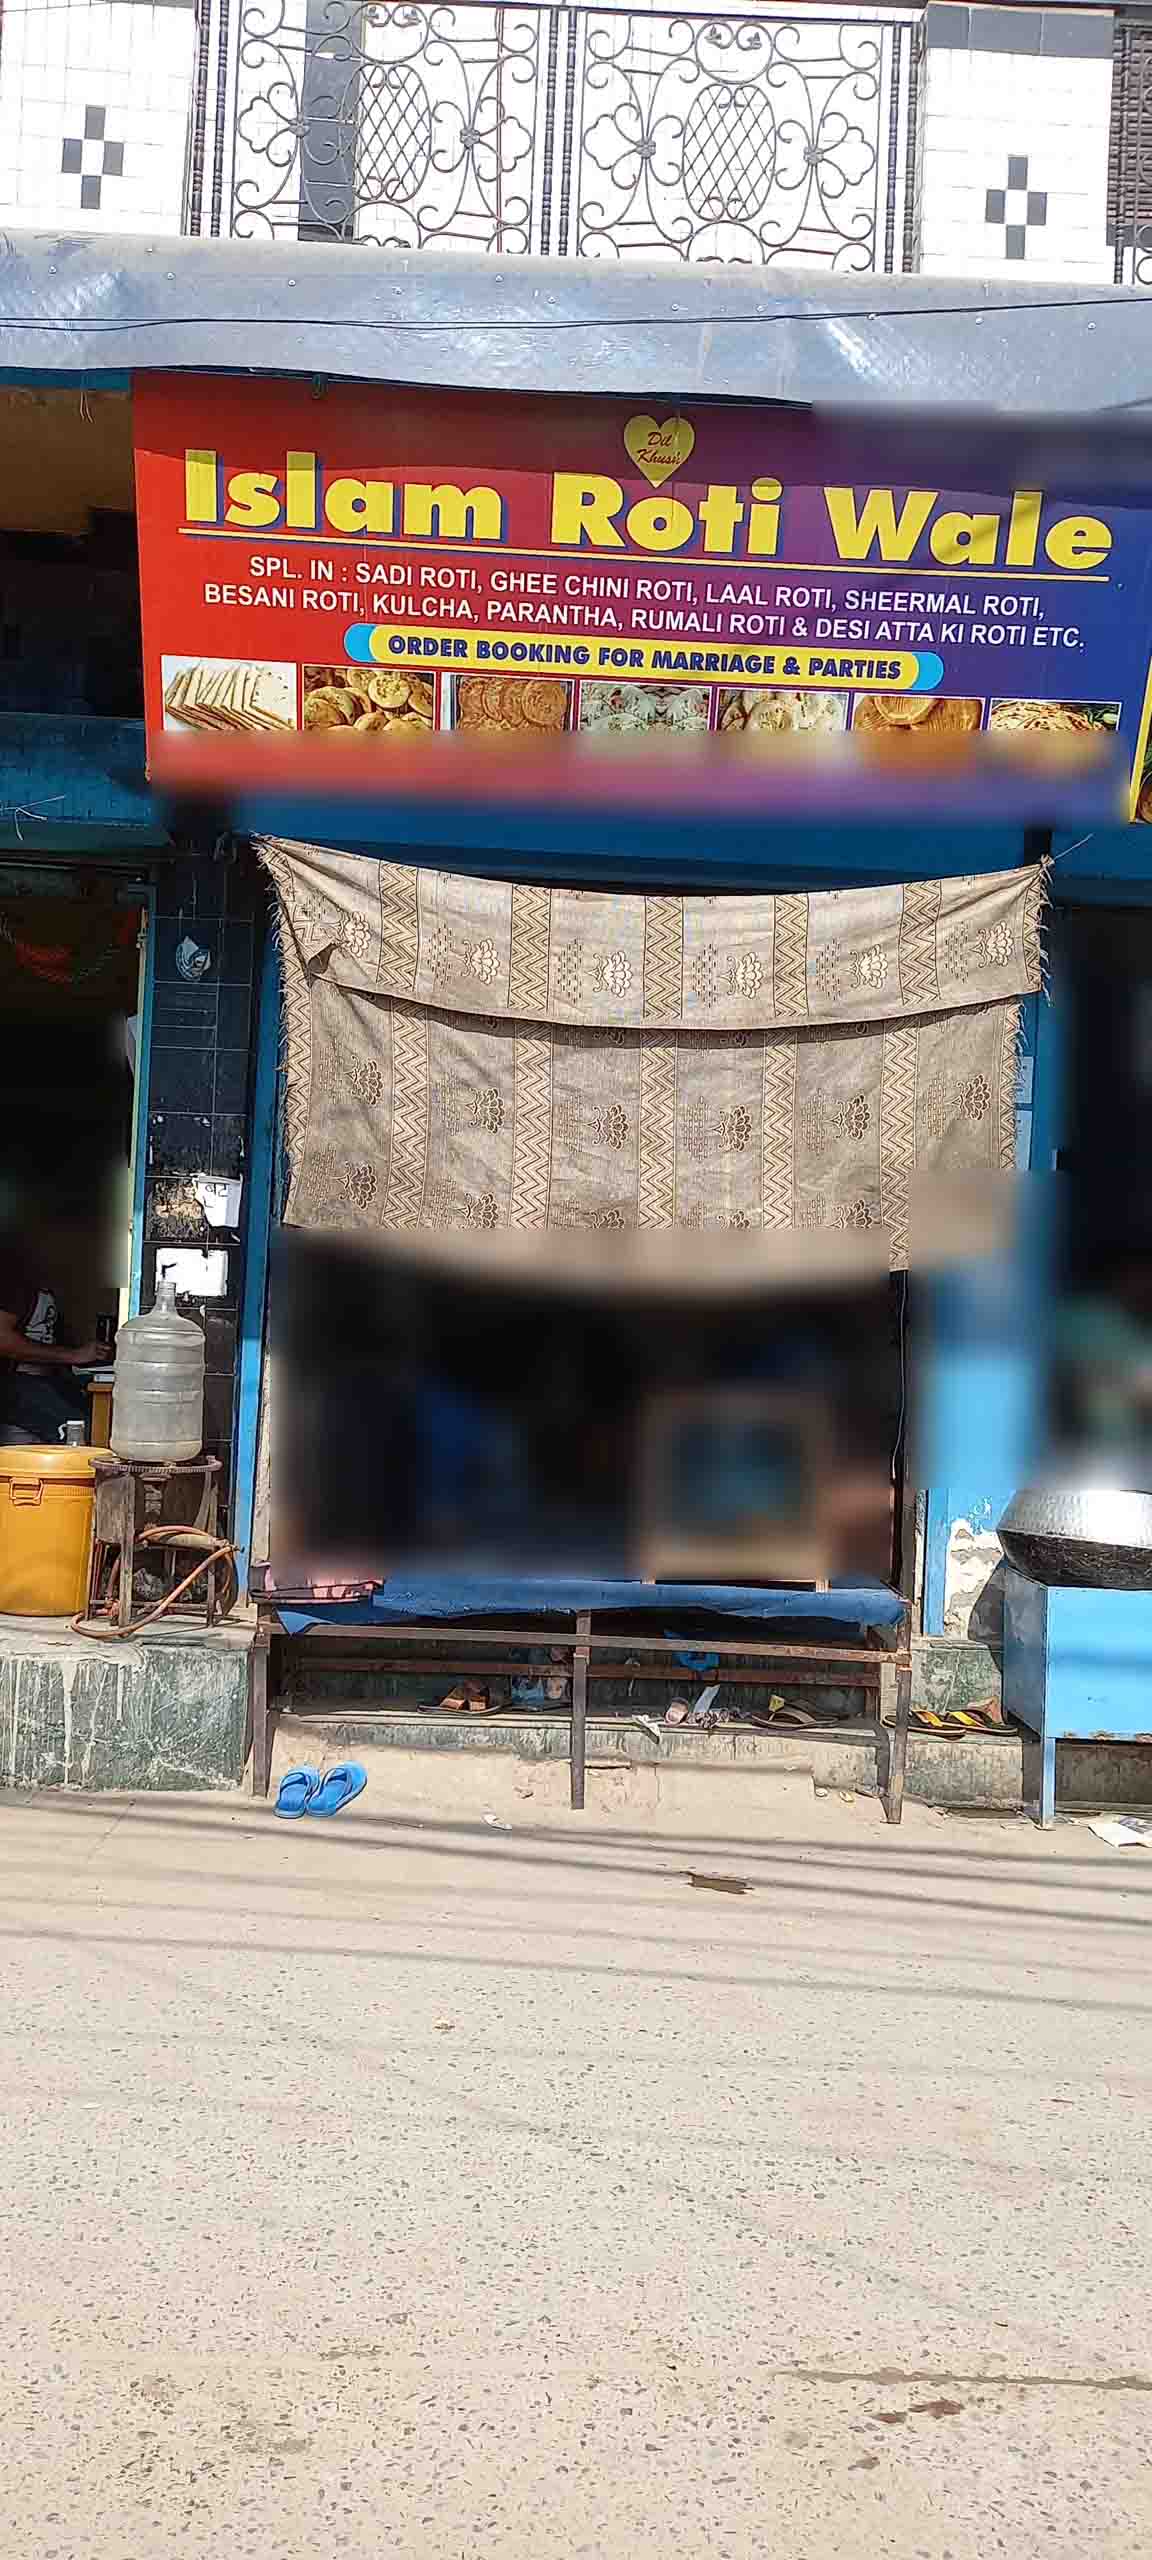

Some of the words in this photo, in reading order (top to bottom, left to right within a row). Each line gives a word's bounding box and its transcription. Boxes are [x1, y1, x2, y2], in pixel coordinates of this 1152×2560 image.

[648, 431, 672, 447] Dil
[184, 448, 506, 541] Islam
[551, 471, 784, 556] Roti
[823, 486, 1113, 570] Wale
[204, 583, 294, 608] BESANI
[302, 590, 365, 616] ROTI,
[373, 594, 479, 623] KULCHA,
[487, 601, 623, 631] PARANTHA,
[632, 609, 722, 633] RUMALI
[729, 614, 785, 636] ROTI
[792, 617, 808, 637] &
[815, 618, 870, 641] DESI
[875, 621, 934, 643] ATTA
[940, 624, 964, 644] KI
[970, 625, 1026, 646] ROTI
[1032, 627, 1085, 648] ETC.
[250, 556, 302, 579] SPL.
[310, 560, 333, 581] IN
[355, 563, 412, 585] SADI
[420, 566, 483, 593] ROTI,
[490, 571, 557, 594] GHEE
[565, 575, 628, 598] CHINI
[636, 579, 698, 604] ROTI,
[706, 584, 768, 606] LAAL
[776, 587, 836, 612] ROTI,
[845, 590, 976, 615] SHEERMAL
[983, 596, 1044, 621] ROTI,
[388, 635, 468, 658] ORDER
[476, 640, 590, 666] BOOKING
[598, 648, 644, 668] FOR
[651, 650, 775, 674] MARRIAGE
[782, 657, 801, 676] &
[808, 657, 902, 680] PARTIES
